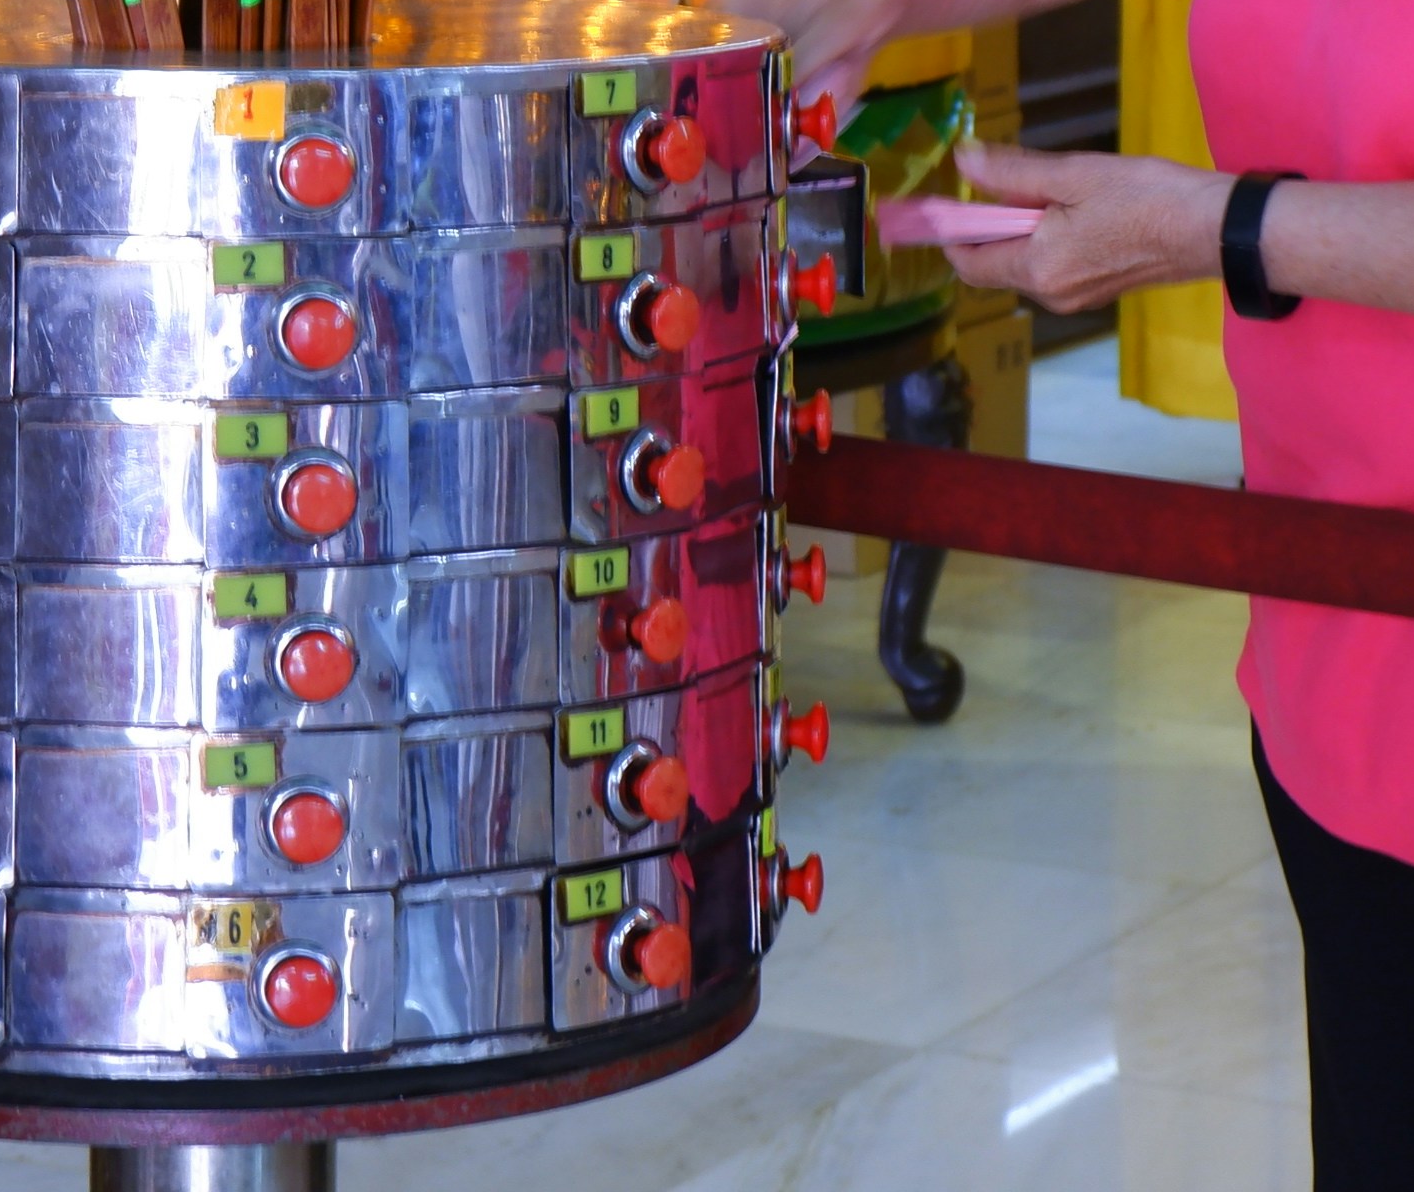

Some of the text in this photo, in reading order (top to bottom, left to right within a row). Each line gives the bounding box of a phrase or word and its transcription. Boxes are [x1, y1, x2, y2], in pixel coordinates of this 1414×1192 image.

[242, 87, 254, 120] 1
[605, 79, 616, 106] 7
[242, 252, 256, 278] 2
[602, 244, 613, 272] 8
[609, 398, 620, 426] 9
[245, 423, 260, 450] 3
[594, 558, 614, 584] 10
[244, 584, 258, 609] 4
[590, 719, 606, 745] 11
[233, 754, 248, 779] 5
[584, 880, 606, 908] 12
[228, 910, 242, 945] 6
